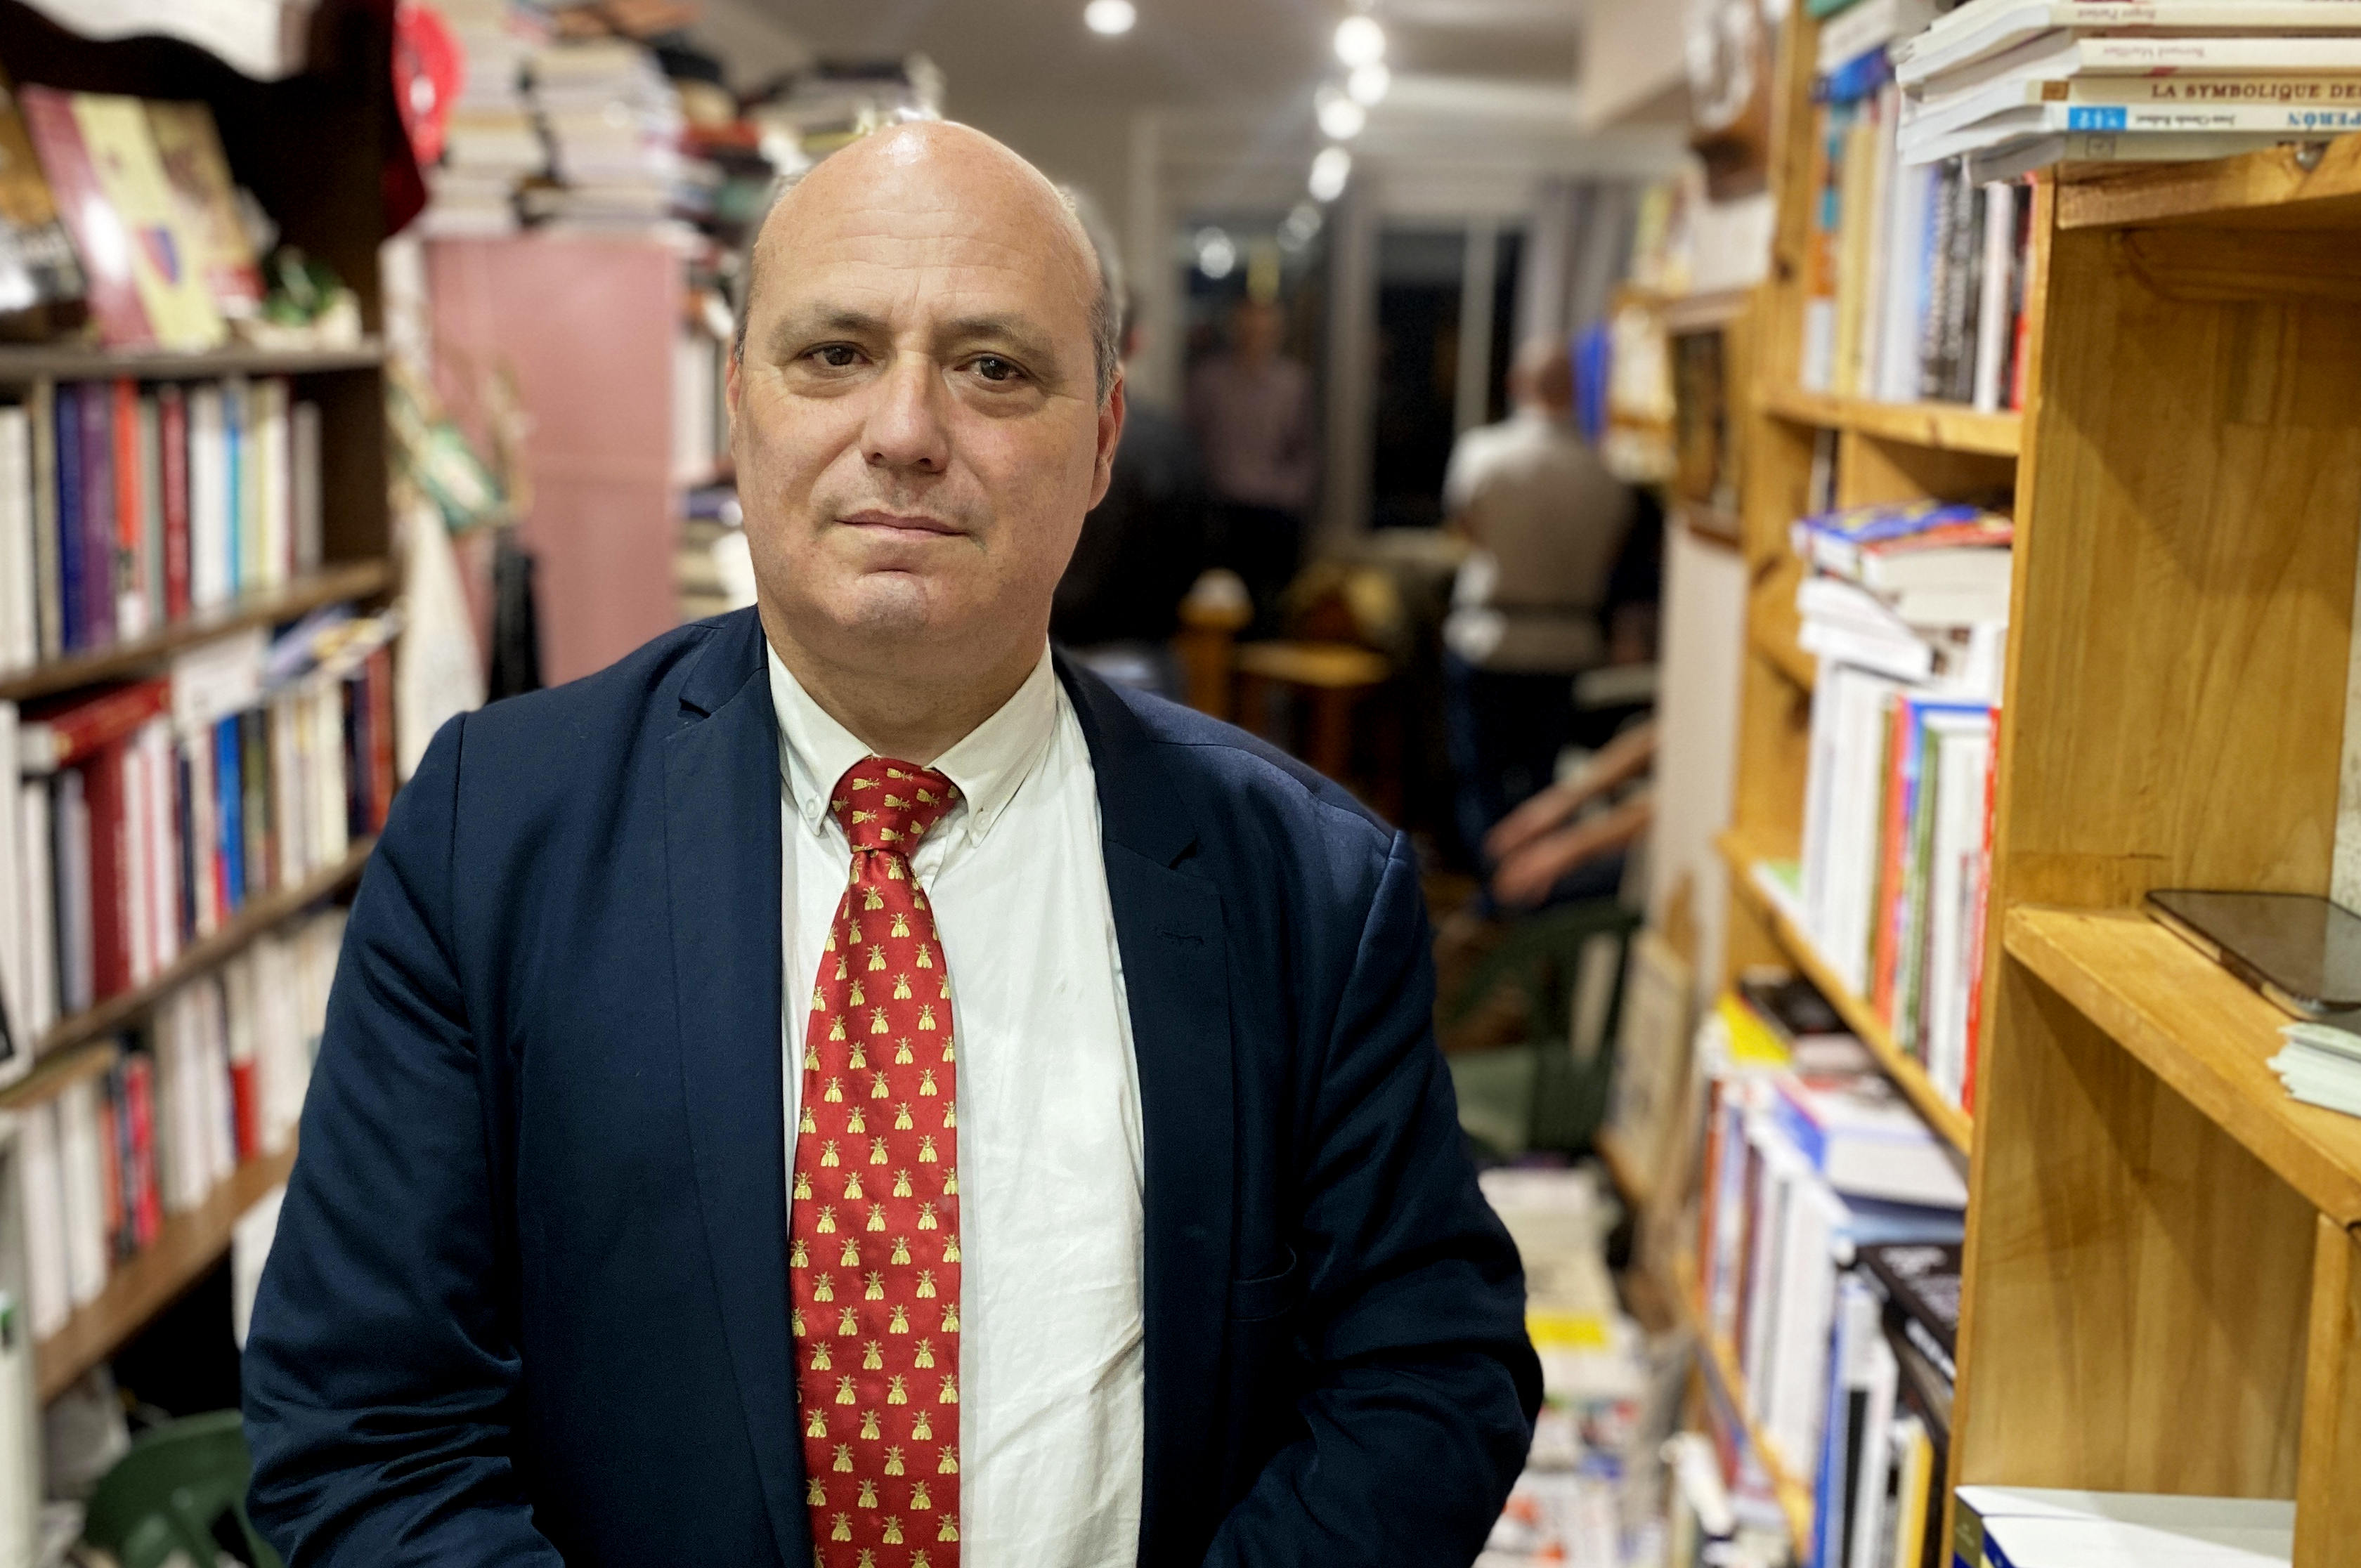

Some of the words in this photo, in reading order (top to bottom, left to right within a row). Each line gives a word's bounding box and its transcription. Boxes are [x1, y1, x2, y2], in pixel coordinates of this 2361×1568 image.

[2151, 84, 2176, 98] LA
[2185, 84, 2321, 102] SYMBOLIQUE
[2330, 84, 2361, 98] DE
